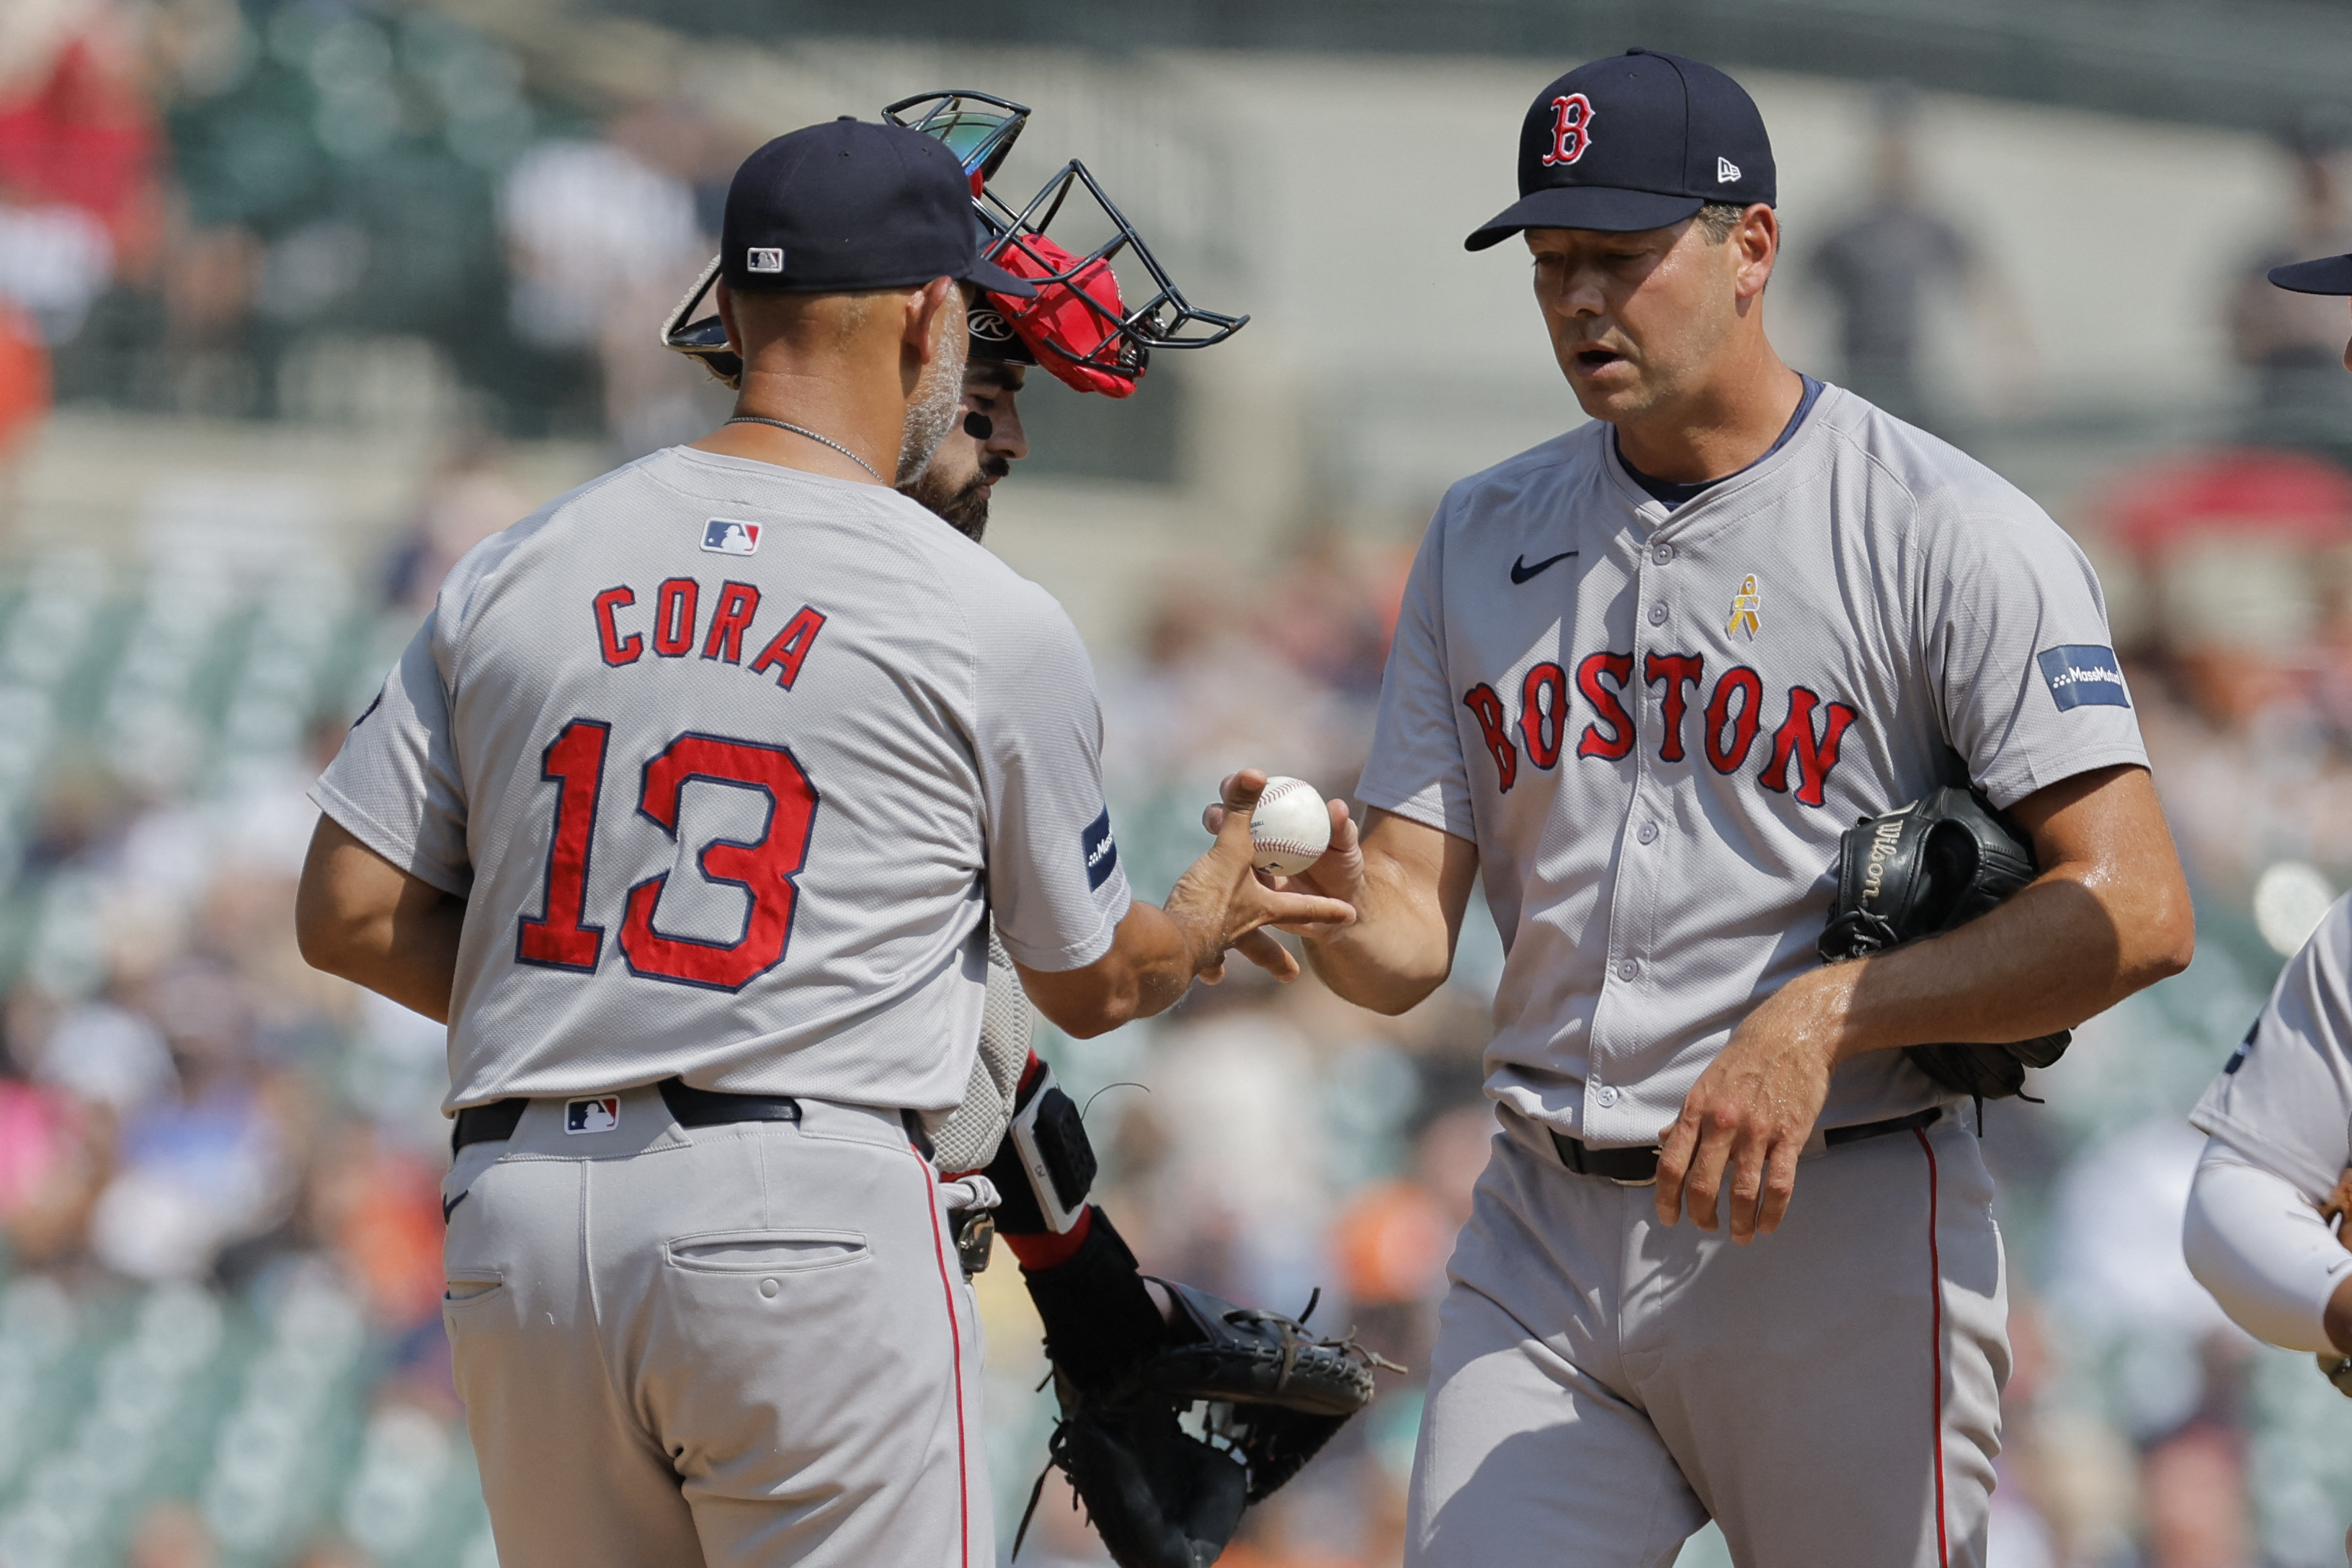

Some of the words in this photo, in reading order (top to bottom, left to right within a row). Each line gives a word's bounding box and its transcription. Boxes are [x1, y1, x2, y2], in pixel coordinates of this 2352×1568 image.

[1542, 93, 1595, 166] B
[969, 313, 1004, 337] R
[592, 576, 827, 692] CORA
[1463, 650, 1858, 808] BOSTON
[514, 716, 820, 994] 13
[1862, 819, 1904, 898] Wilson
